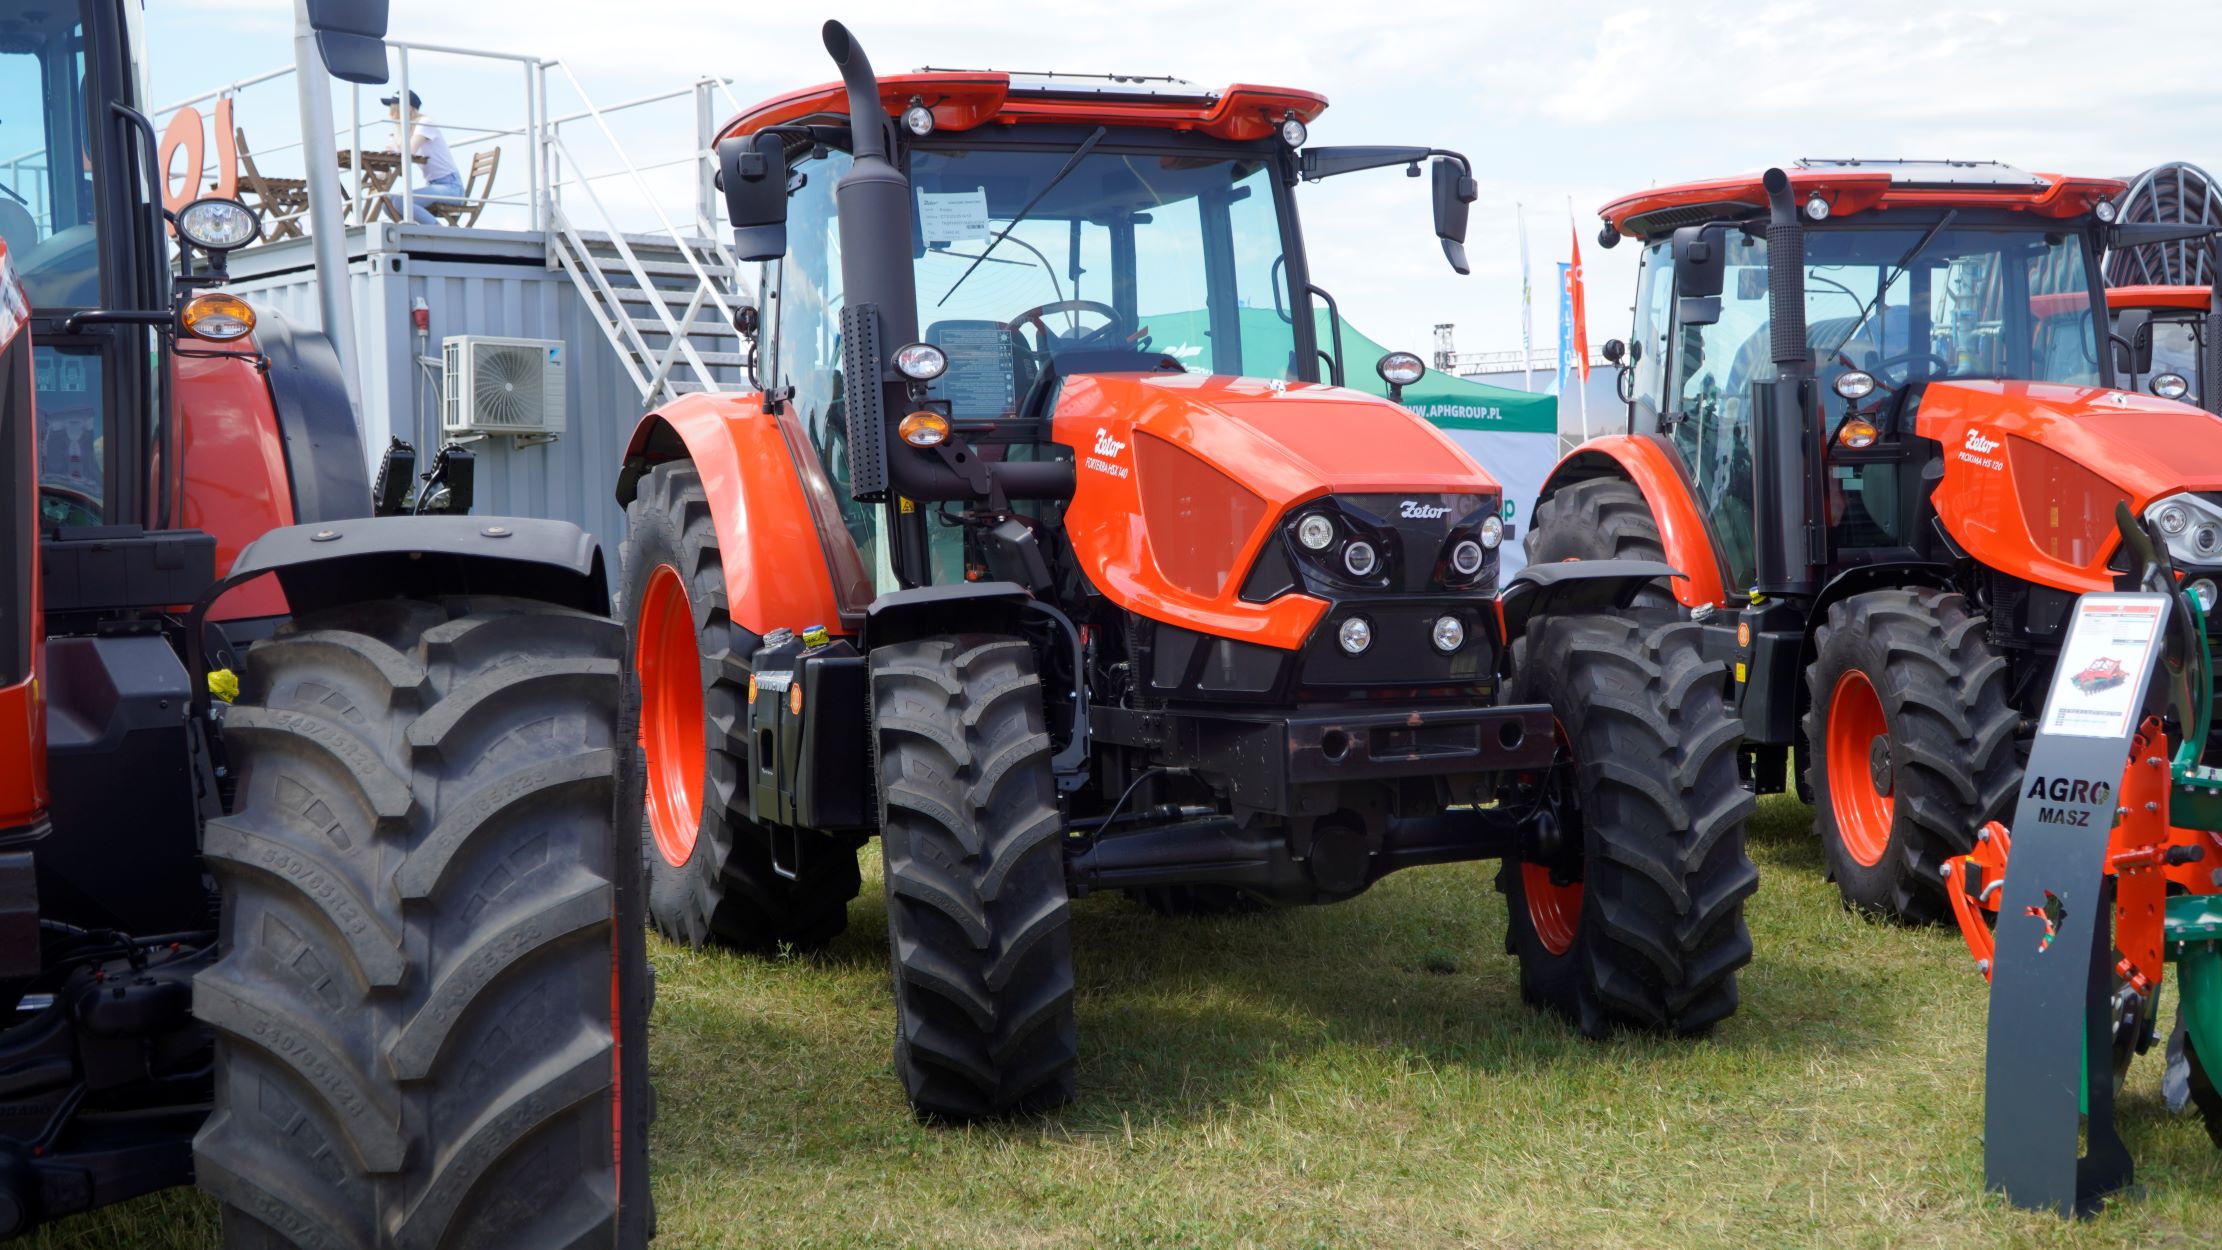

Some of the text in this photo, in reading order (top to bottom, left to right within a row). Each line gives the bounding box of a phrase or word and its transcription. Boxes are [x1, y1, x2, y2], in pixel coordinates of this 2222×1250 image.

[1094, 428, 1126, 458] Zetor
[1965, 428, 2000, 454] Zetor
[1085, 457, 1109, 473] FORTERRA
[1119, 467, 1129, 479] 140
[1958, 451, 2004, 472] PROXIMA HS 120
[1400, 501, 1452, 518] Zetor
[2027, 776, 2110, 805] AGRO
[2038, 807, 2090, 827] MASZ
